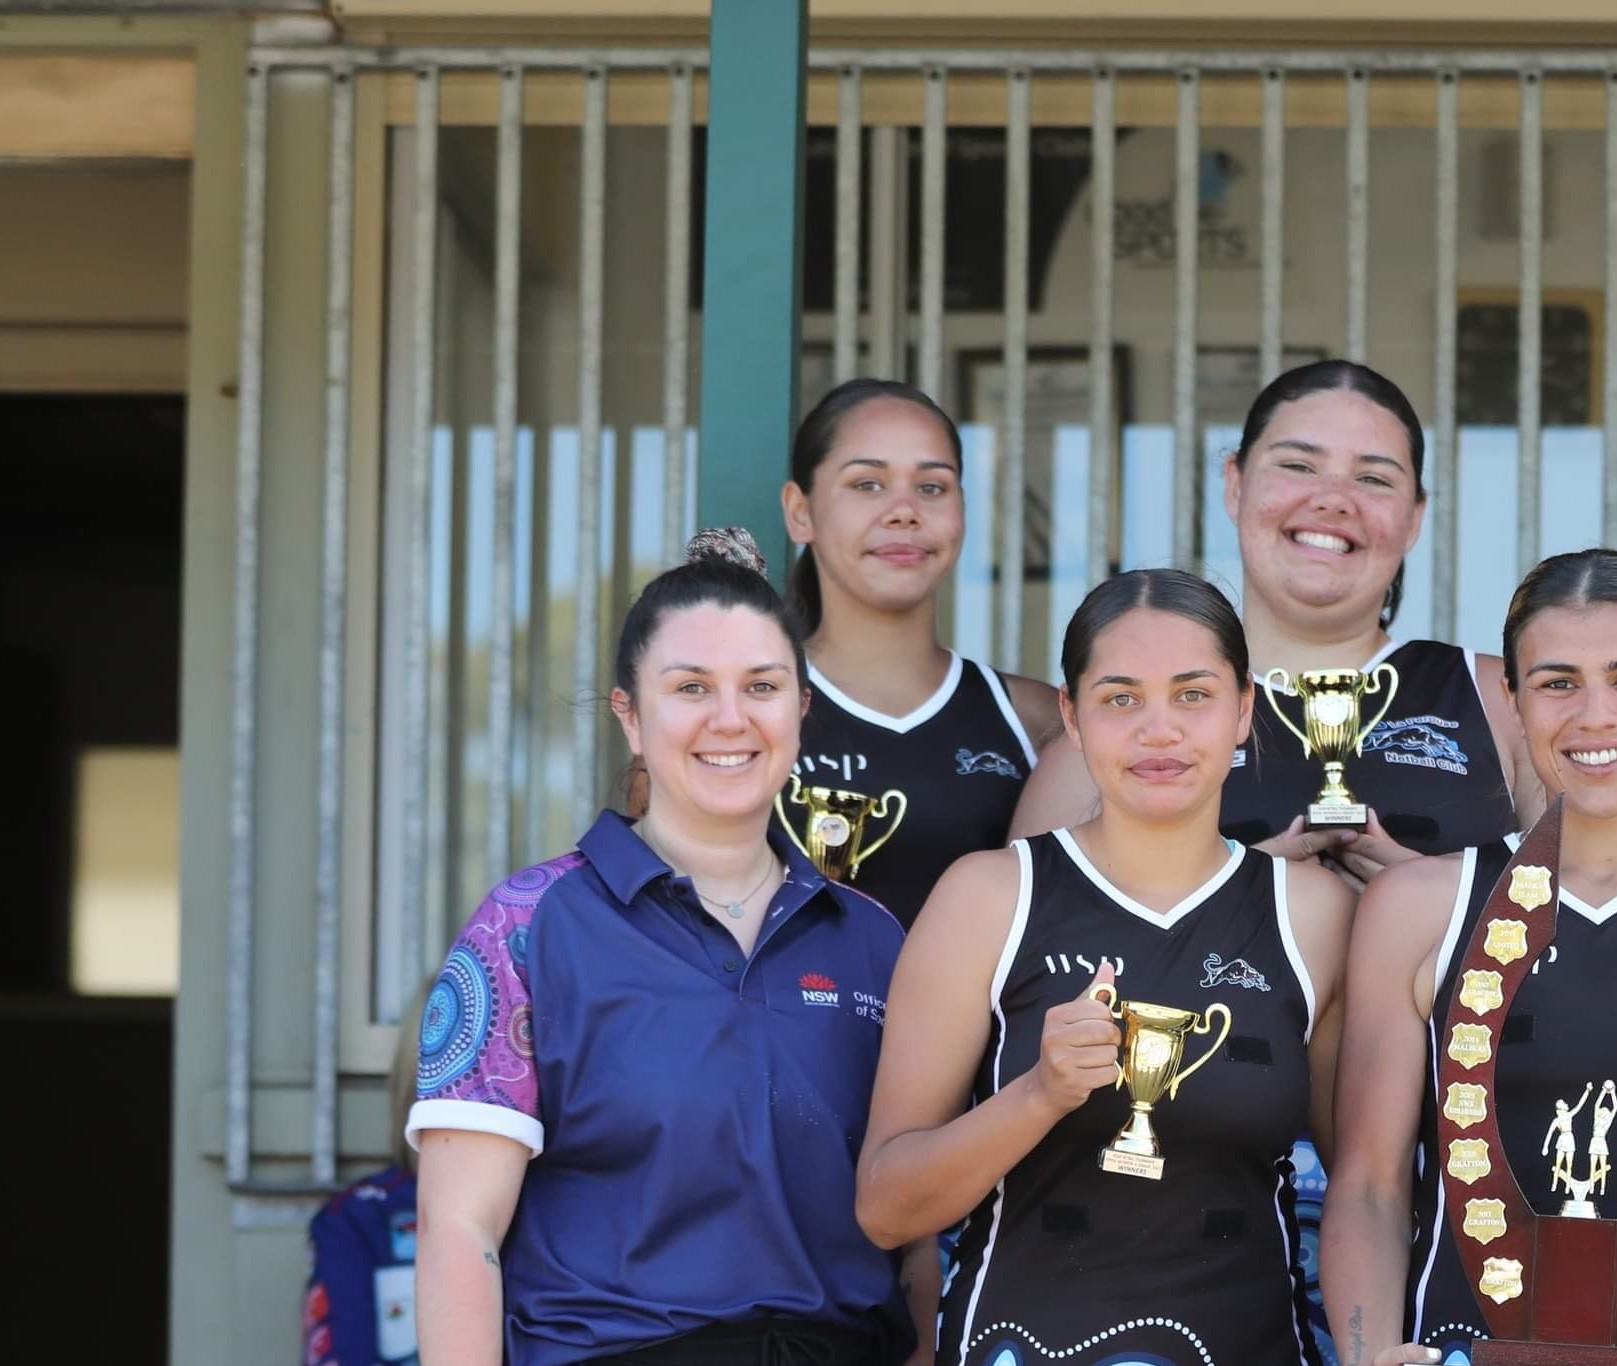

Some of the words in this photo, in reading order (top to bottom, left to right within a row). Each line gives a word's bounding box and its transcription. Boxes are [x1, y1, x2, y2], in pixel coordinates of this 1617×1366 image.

[1384, 752, 1437, 768] Netball
[1436, 758, 1468, 775] Club
[802, 990, 839, 1003] NSW
[856, 1006, 868, 1016] of
